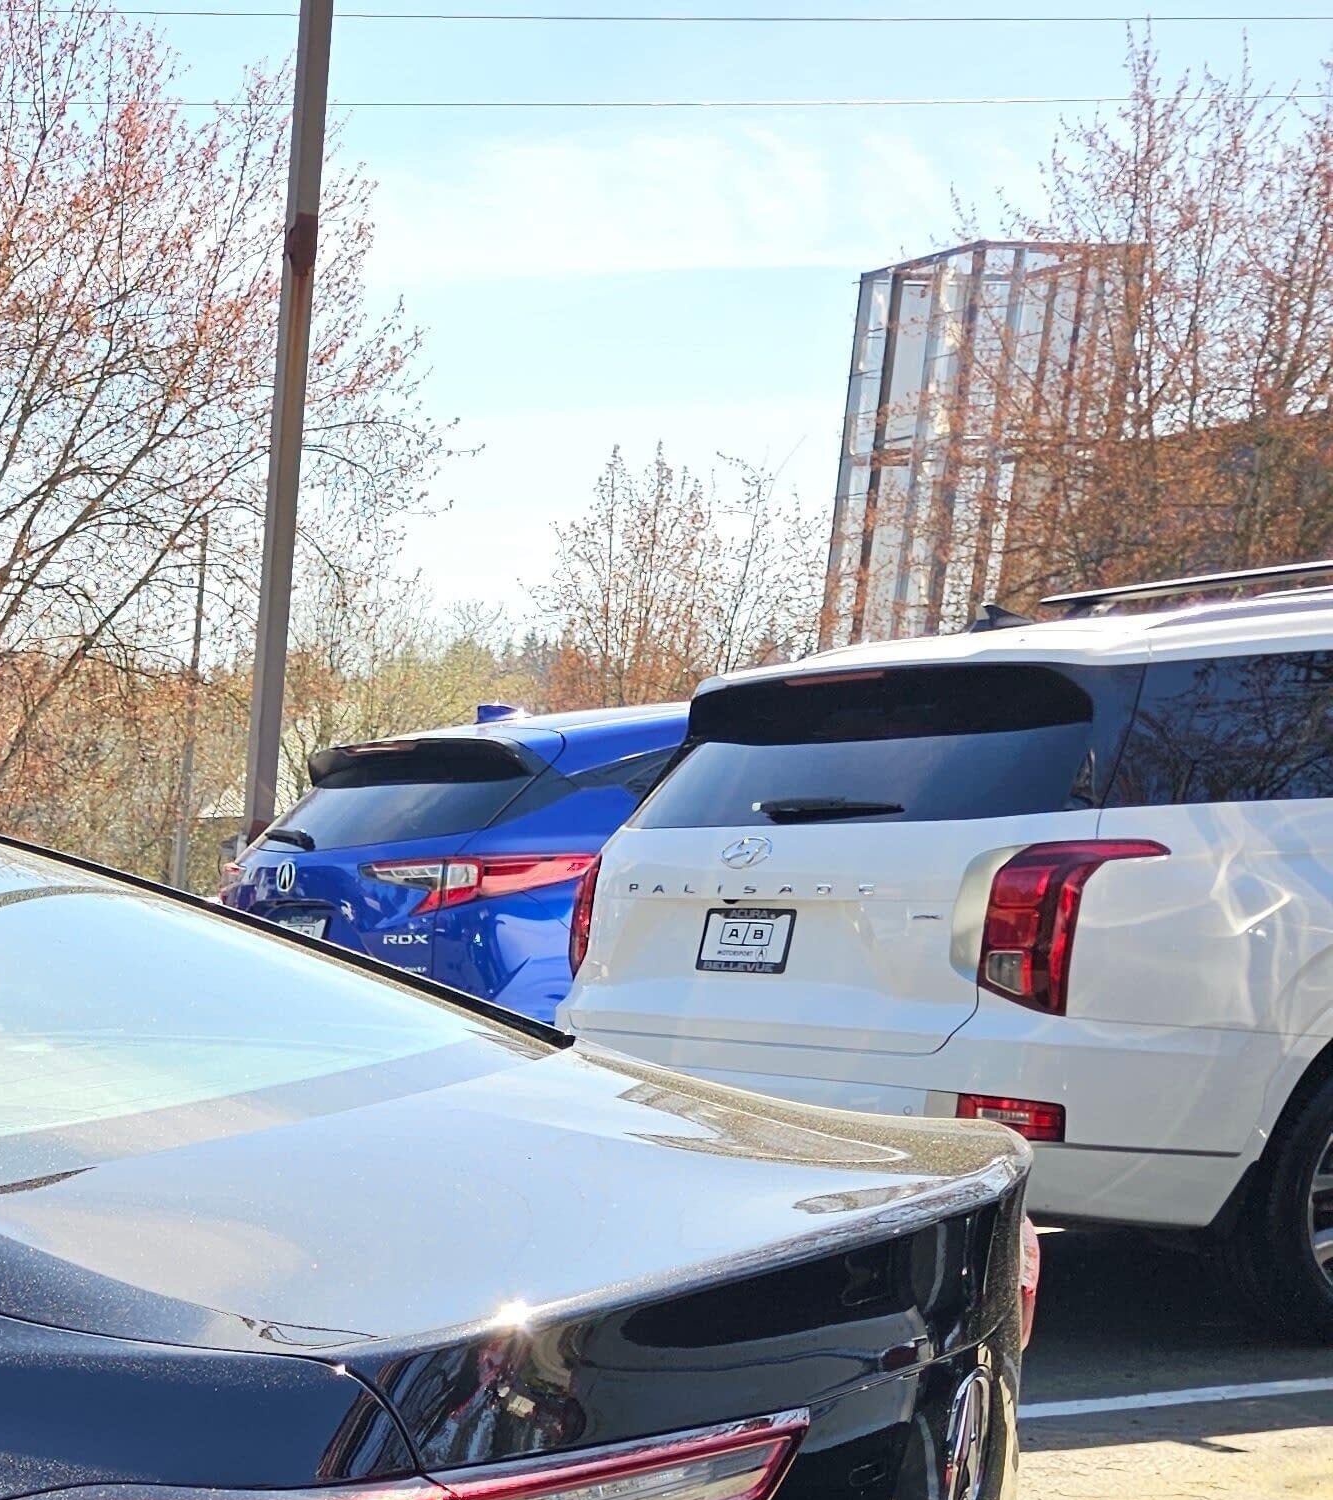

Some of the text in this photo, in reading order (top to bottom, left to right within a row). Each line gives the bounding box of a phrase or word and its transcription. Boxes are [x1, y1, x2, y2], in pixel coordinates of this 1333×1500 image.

[629, 884, 876, 895] PALISADE
[729, 910, 768, 919] ACURA
[728, 929, 764, 939] A B
[383, 935, 428, 945] RDX
[703, 961, 774, 972] BELLEVUE
